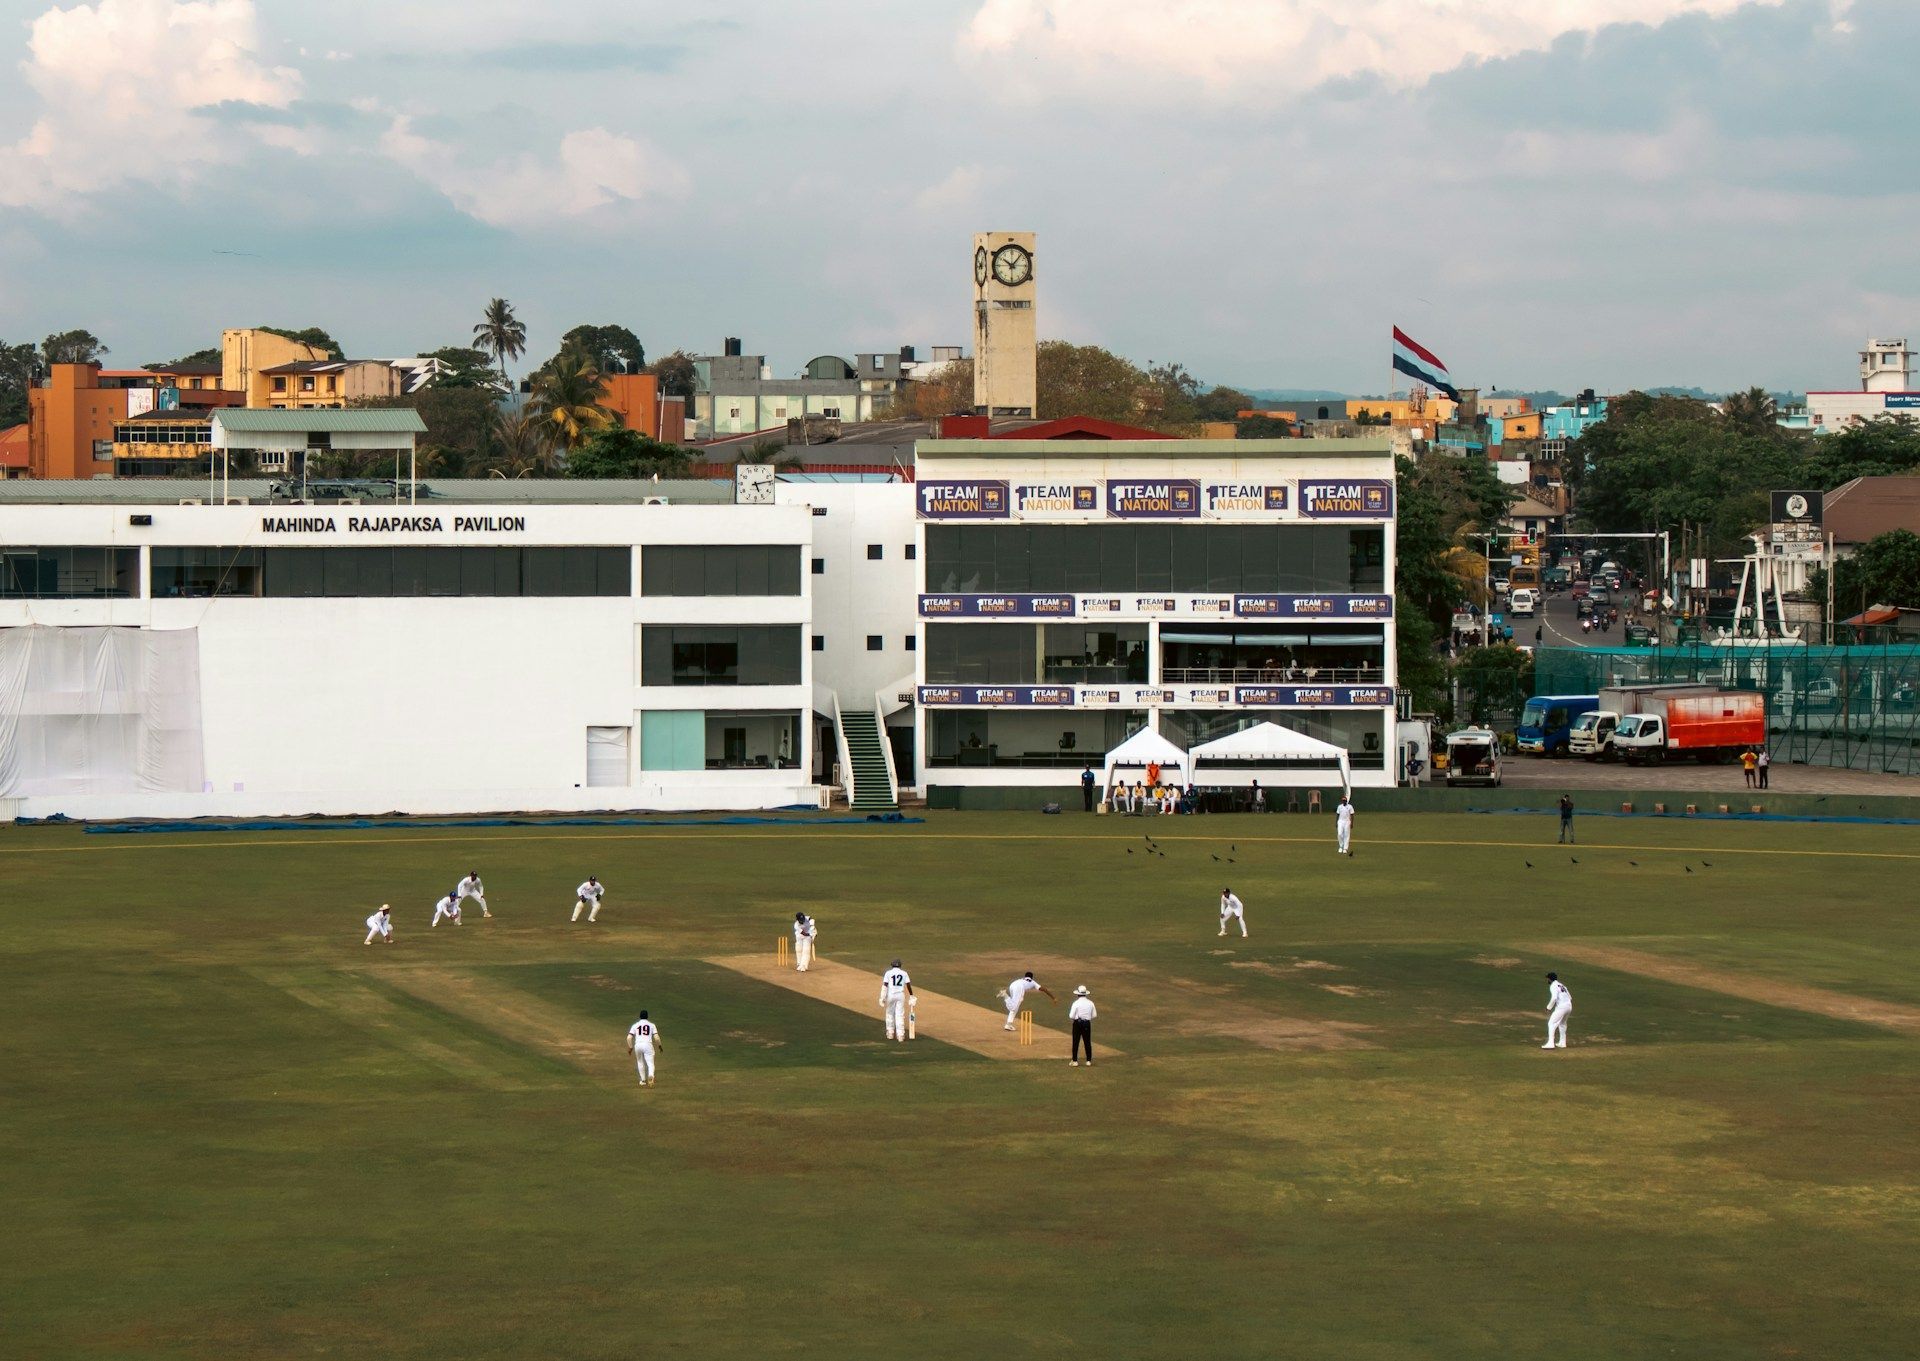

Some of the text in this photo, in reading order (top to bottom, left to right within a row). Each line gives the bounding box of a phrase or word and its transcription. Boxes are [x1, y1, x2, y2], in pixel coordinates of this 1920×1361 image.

[935, 486, 978, 499] TEAM
[1028, 486, 1070, 497] TEAM
[1125, 486, 1168, 498] TEAM
[1219, 486, 1262, 497] TEAM
[1316, 486, 1360, 498] TEAM
[934, 500, 978, 511] NATION
[1027, 499, 1070, 510] NATION
[1124, 499, 1169, 511] NATION
[1218, 499, 1262, 510] NATION
[1316, 499, 1361, 511] NATION
[262, 516, 525, 532] MAHINDA RAJAPAKSA PAVILION
[891, 975, 903, 986] 12
[637, 1025, 650, 1035] 19
